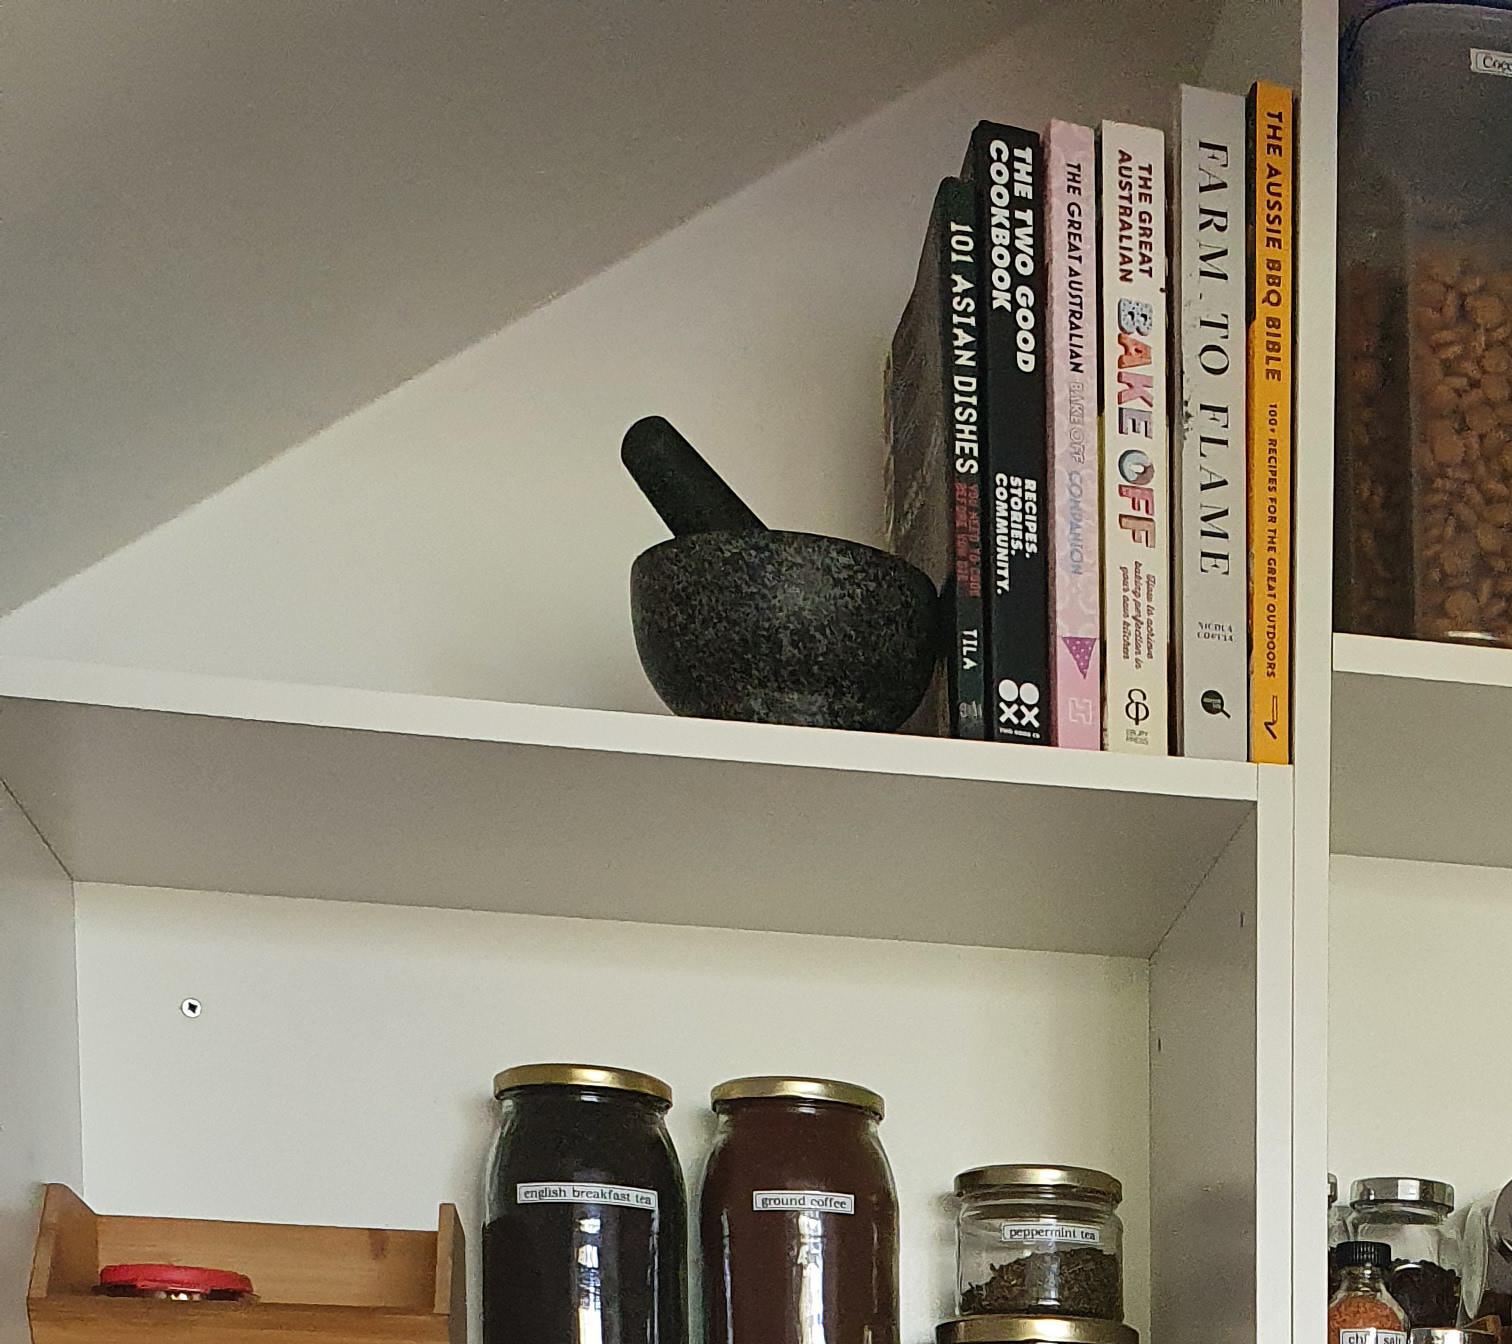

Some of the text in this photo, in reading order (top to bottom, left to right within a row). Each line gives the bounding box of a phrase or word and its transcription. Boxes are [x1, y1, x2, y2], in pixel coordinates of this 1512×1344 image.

[988, 139, 1012, 312] COOKBOOK
[1065, 163, 1081, 198] THE
[1066, 202, 1082, 261] GREAT
[1118, 149, 1133, 283] AUSTRALIAN
[1138, 163, 1153, 279] THE GREAT
[1013, 146, 1036, 374] THE TWO GOOD
[1264, 110, 1283, 382] THE AUSSIE BBQ BIBLE
[950, 221, 979, 475] 101 ASIAN DISHES
[1067, 265, 1085, 374] AUSTRALIAN
[1198, 140, 1231, 577] FARM TO FLAME
[1117, 298, 1157, 550] BAKE OFF
[995, 472, 1010, 595] COMMUNITY.
[1009, 475, 1024, 556] STORIES.
[1024, 478, 1038, 559] RECIPES.
[523, 1187, 653, 1206] english breakfast tea
[761, 1195, 848, 1210] ground coffee
[1009, 1226, 1097, 1241] peppermint tea
